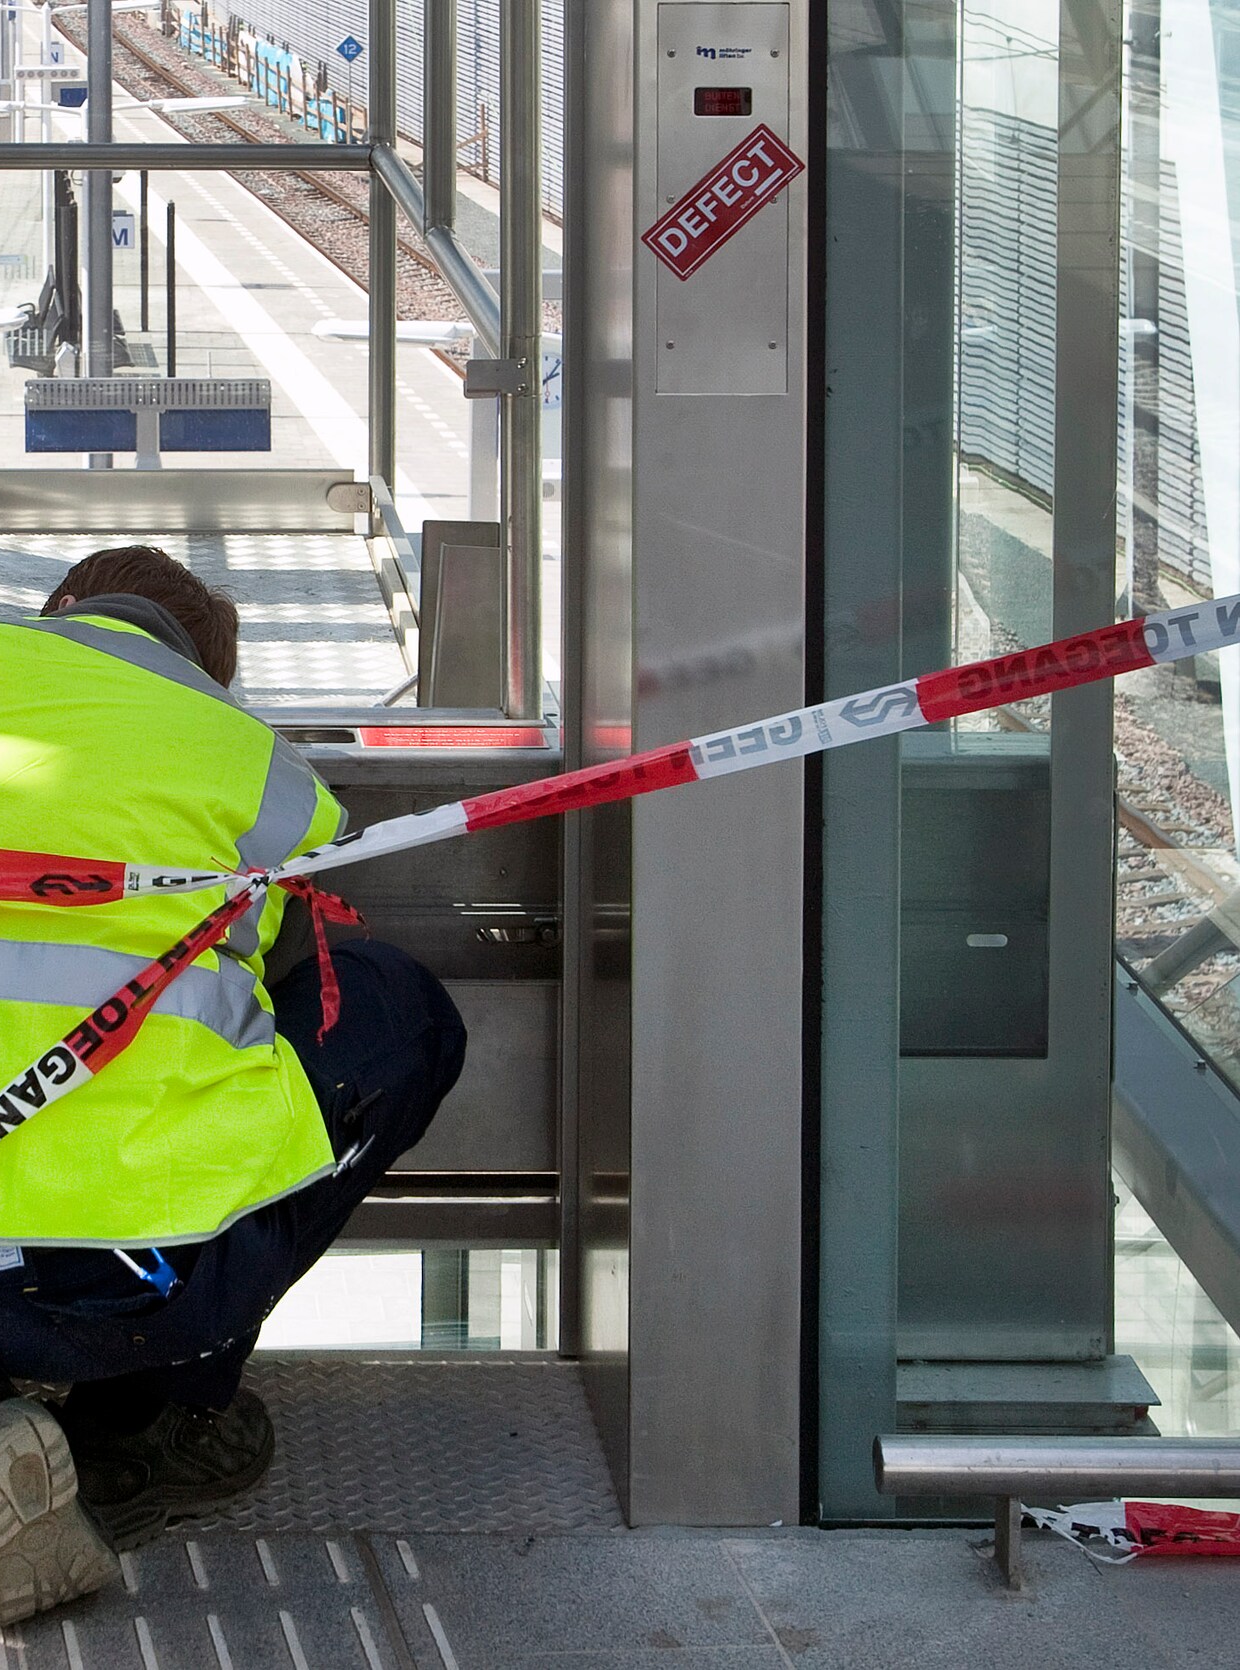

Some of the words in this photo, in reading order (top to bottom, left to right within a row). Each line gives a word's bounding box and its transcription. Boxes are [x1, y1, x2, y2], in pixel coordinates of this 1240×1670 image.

[344, 44, 357, 54] 12
[658, 140, 775, 258] DEFECT
[113, 228, 129, 246] M
